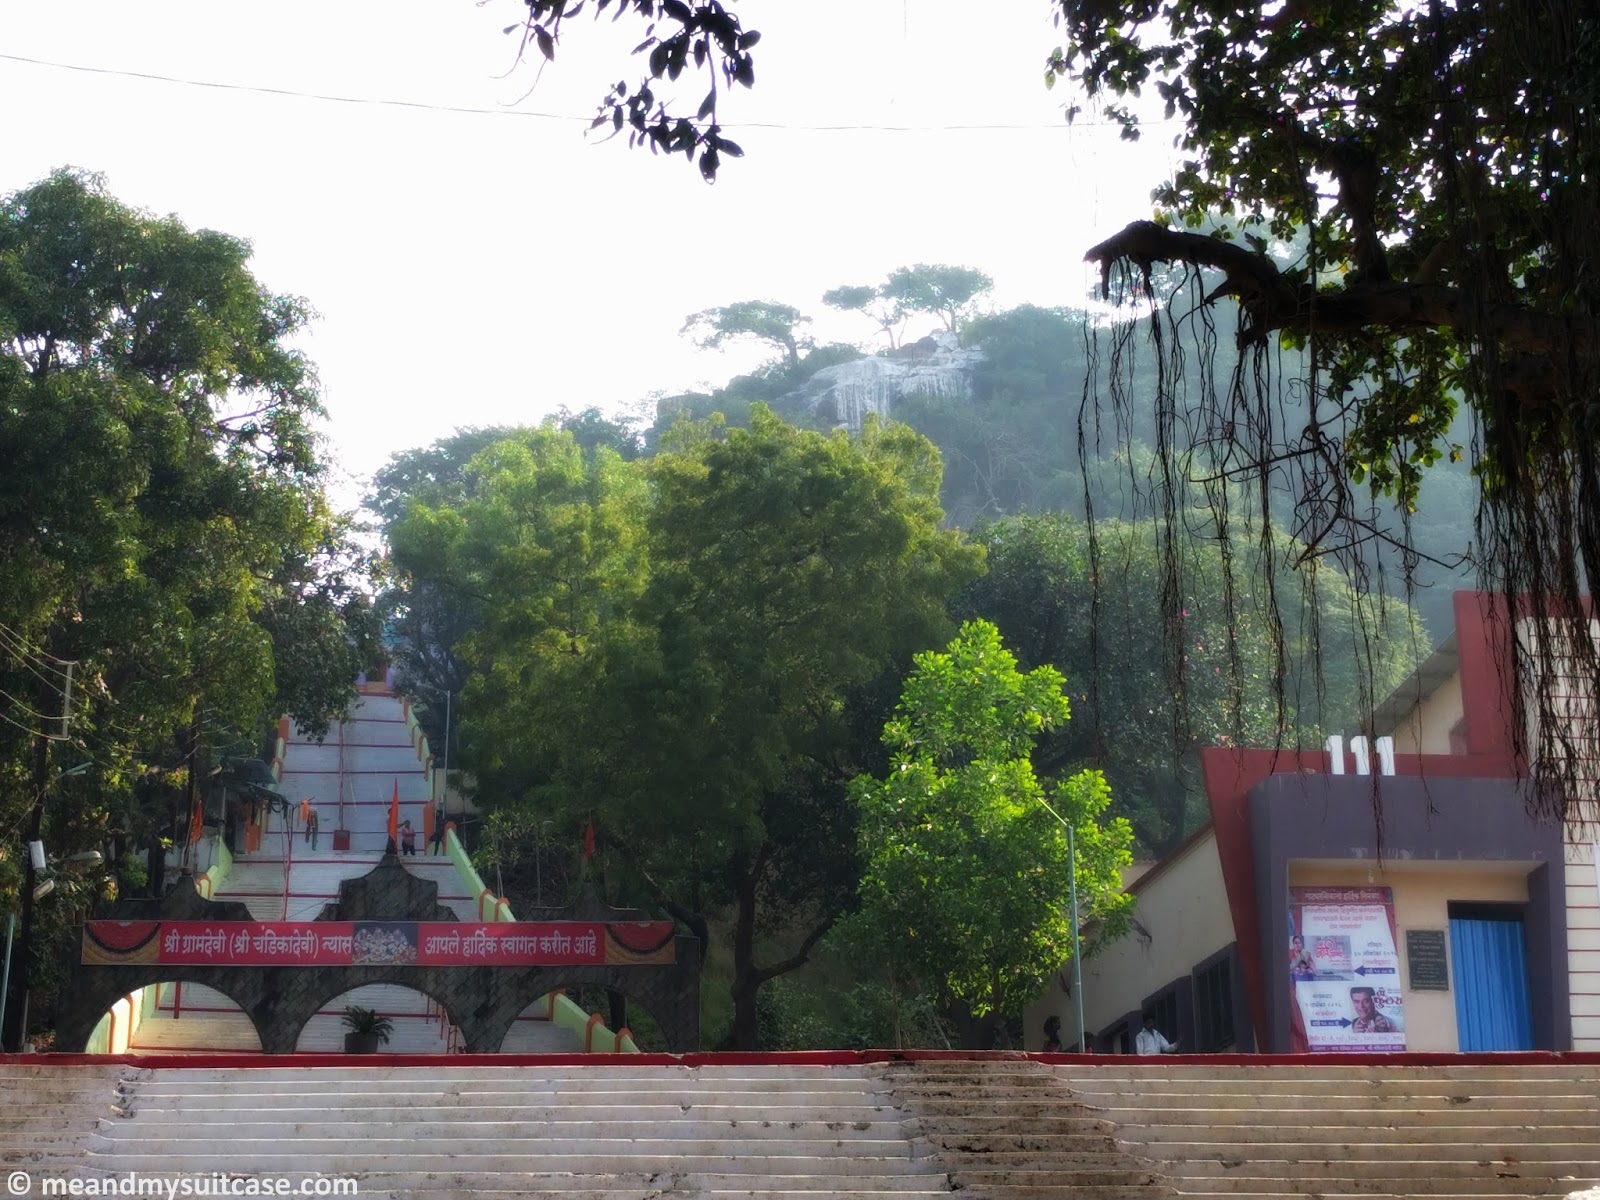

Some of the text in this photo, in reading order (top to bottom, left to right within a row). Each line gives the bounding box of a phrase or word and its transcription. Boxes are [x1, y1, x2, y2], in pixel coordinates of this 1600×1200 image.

[164, 925, 353, 959] श्री ग्रामदेवी (श्री चंडिकादेवी) न्यास
[425, 927, 597, 958] आपले हार्दिक स्वागत करीत आहे
